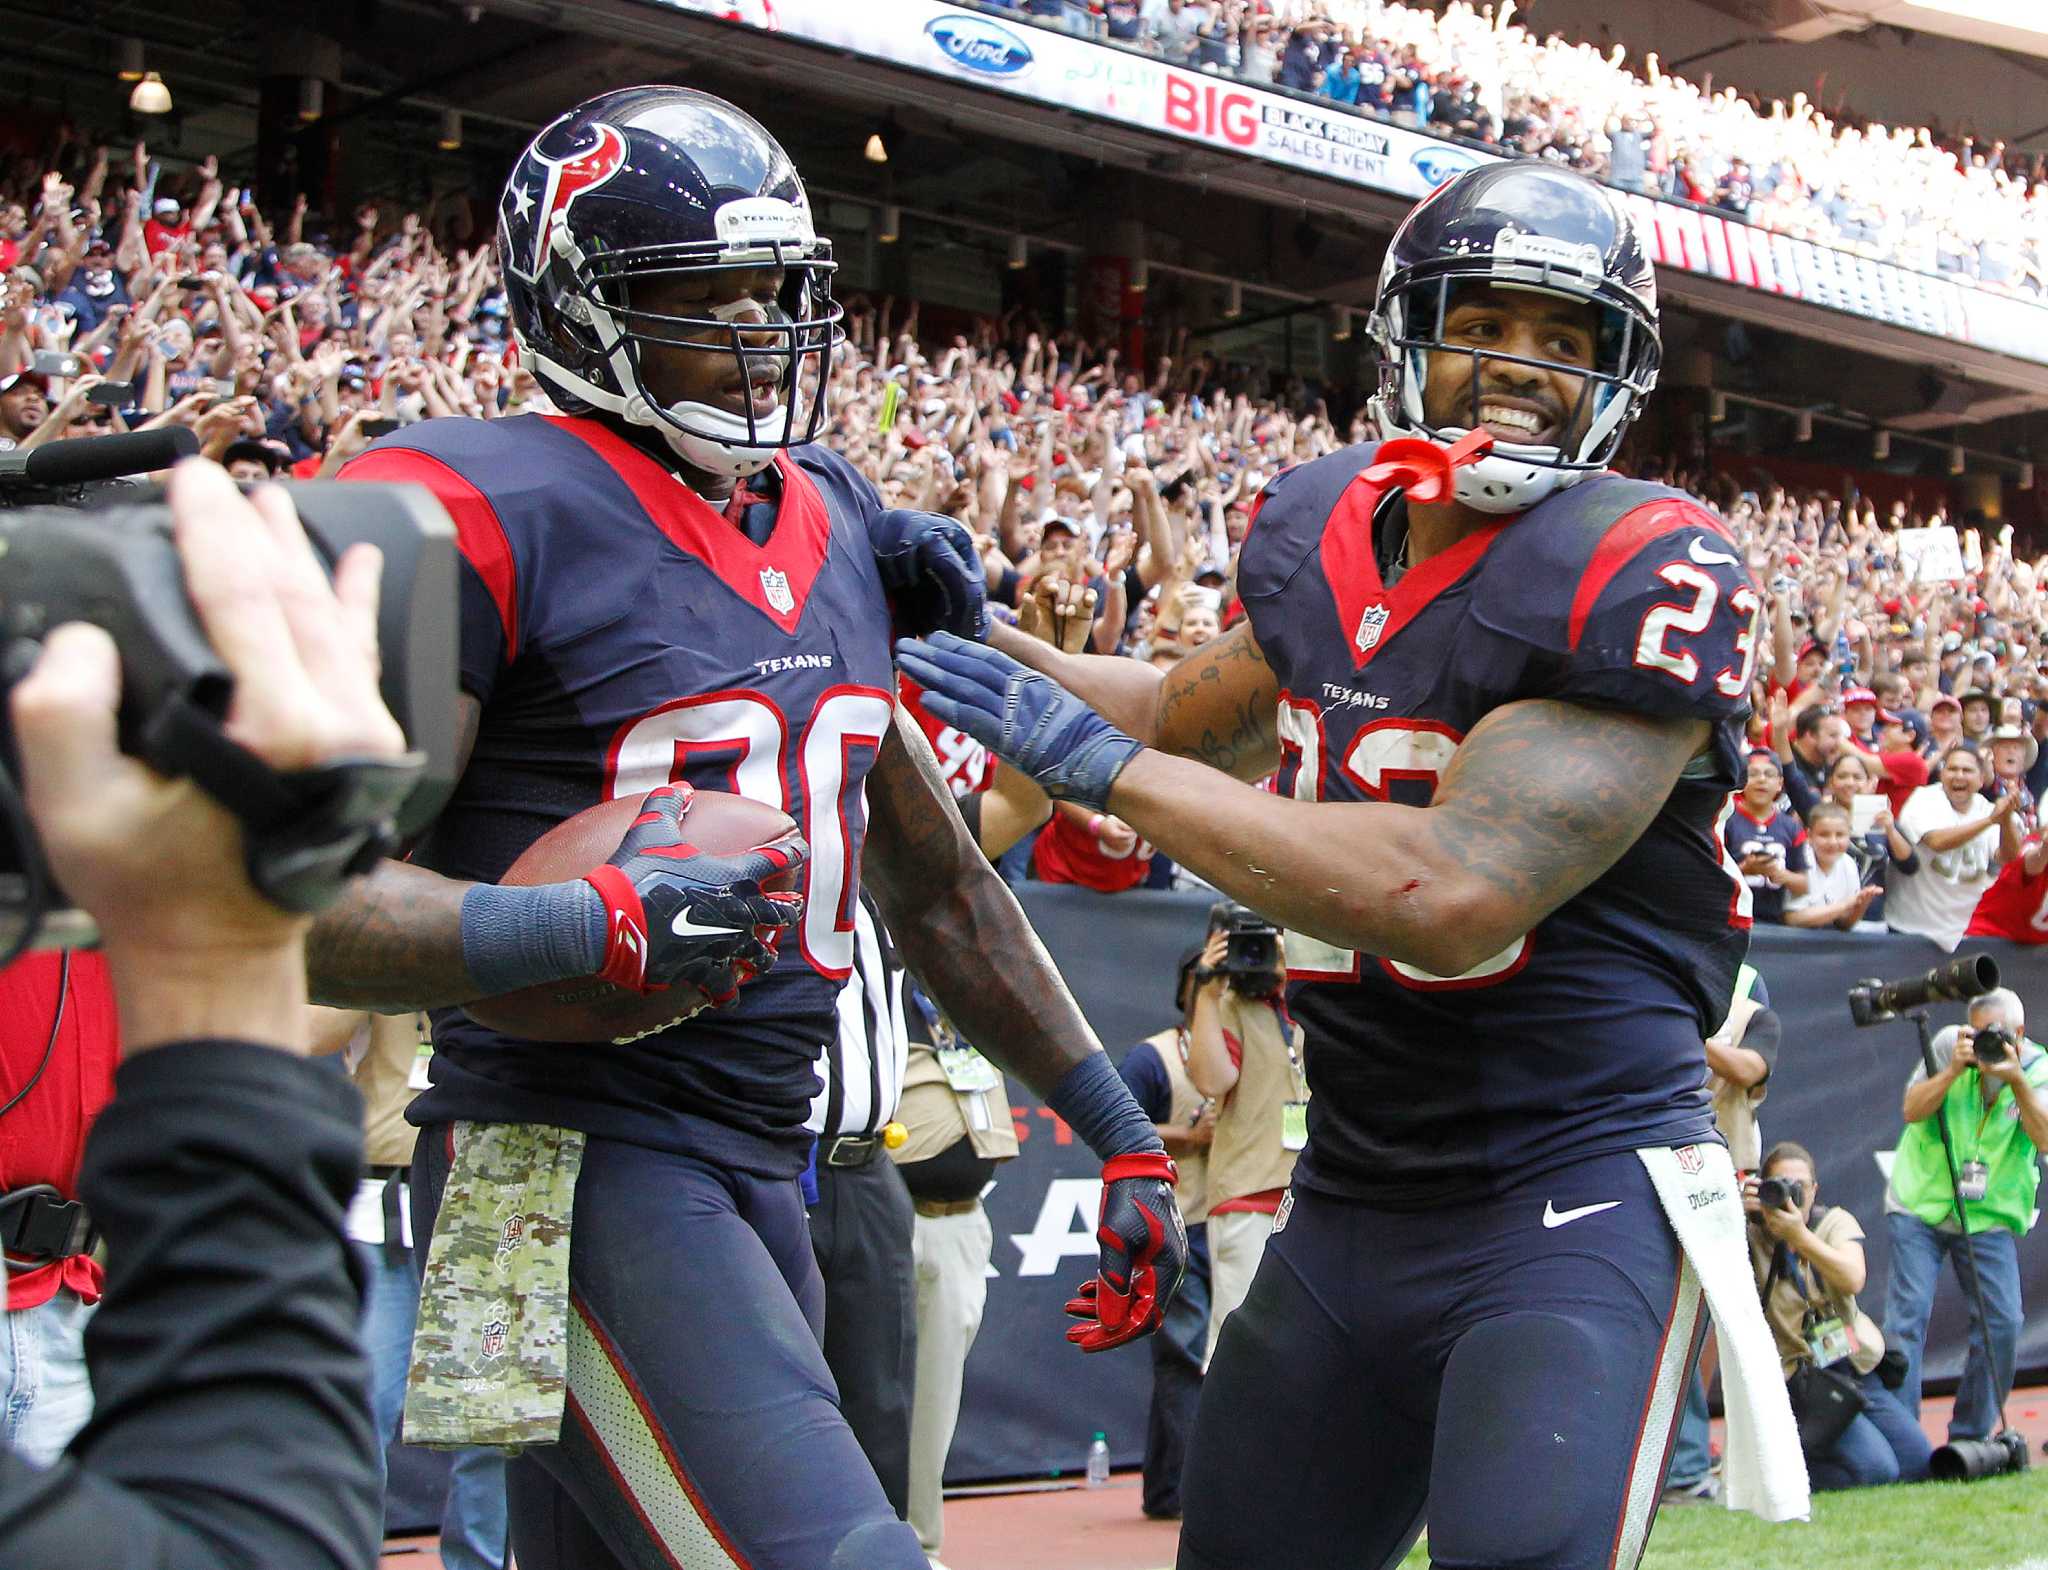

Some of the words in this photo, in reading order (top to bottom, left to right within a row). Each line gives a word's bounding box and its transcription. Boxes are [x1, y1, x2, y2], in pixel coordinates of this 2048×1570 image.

[948, 30, 1010, 66] Ford
[1165, 72, 1260, 146] BIG
[1265, 107, 1325, 139] BLACK
[1325, 123, 1388, 155] FRIDAY
[1266, 131, 1325, 160] SALES
[1330, 146, 1387, 177] EVENT
[1632, 560, 1762, 699] 23
[753, 654, 833, 675] TEXANS
[1322, 683, 1391, 709] TEXANS
